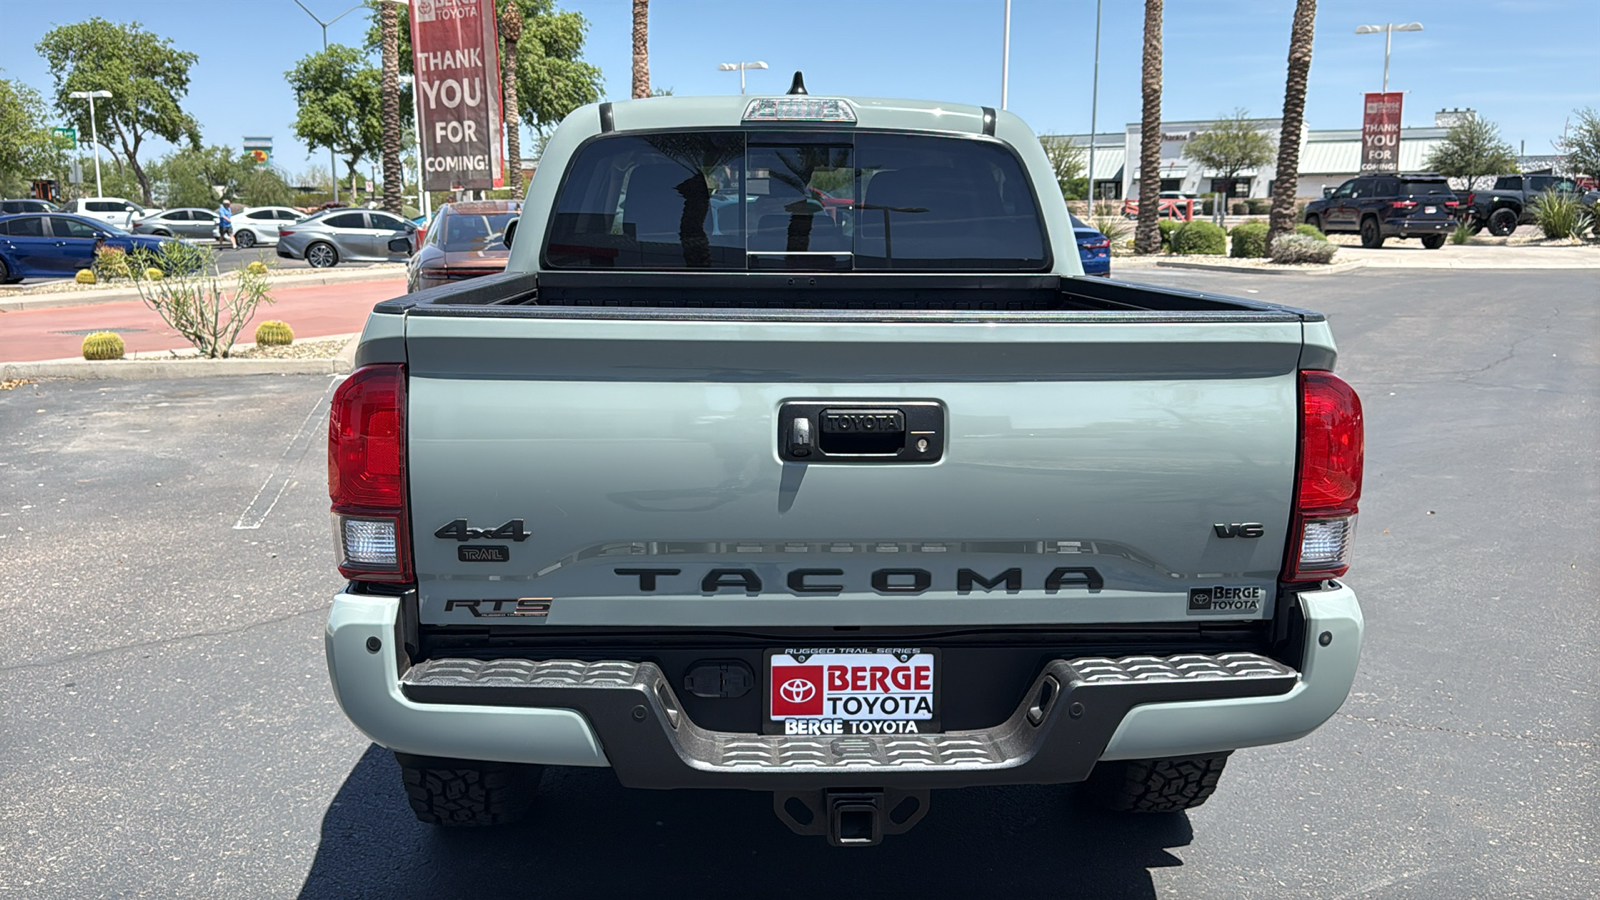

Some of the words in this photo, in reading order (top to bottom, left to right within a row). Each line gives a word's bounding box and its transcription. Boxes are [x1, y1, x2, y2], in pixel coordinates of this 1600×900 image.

[436, 7, 478, 20] TOYOTA
[417, 48, 482, 71] THANK
[421, 77, 481, 109] YOU
[435, 120, 478, 143] FOR
[1365, 124, 1399, 132] THANK
[1365, 134, 1397, 147] YOU
[1368, 149, 1392, 160] FOR
[425, 154, 489, 172] COMING!
[827, 415, 899, 431] TOYOTA
[434, 518, 532, 542] 4x4
[1213, 522, 1264, 538] V6
[463, 549, 503, 560] TRAIL
[614, 567, 1104, 594] TACOMA
[1213, 586, 1259, 600] BERGE
[444, 597, 553, 617] RTS
[1212, 601, 1258, 610] TOYOTA
[827, 665, 931, 694] BERGE
[827, 696, 932, 715] TOYOTA
[785, 719, 844, 735] BERGE
[849, 720, 918, 733] TOYOTA
